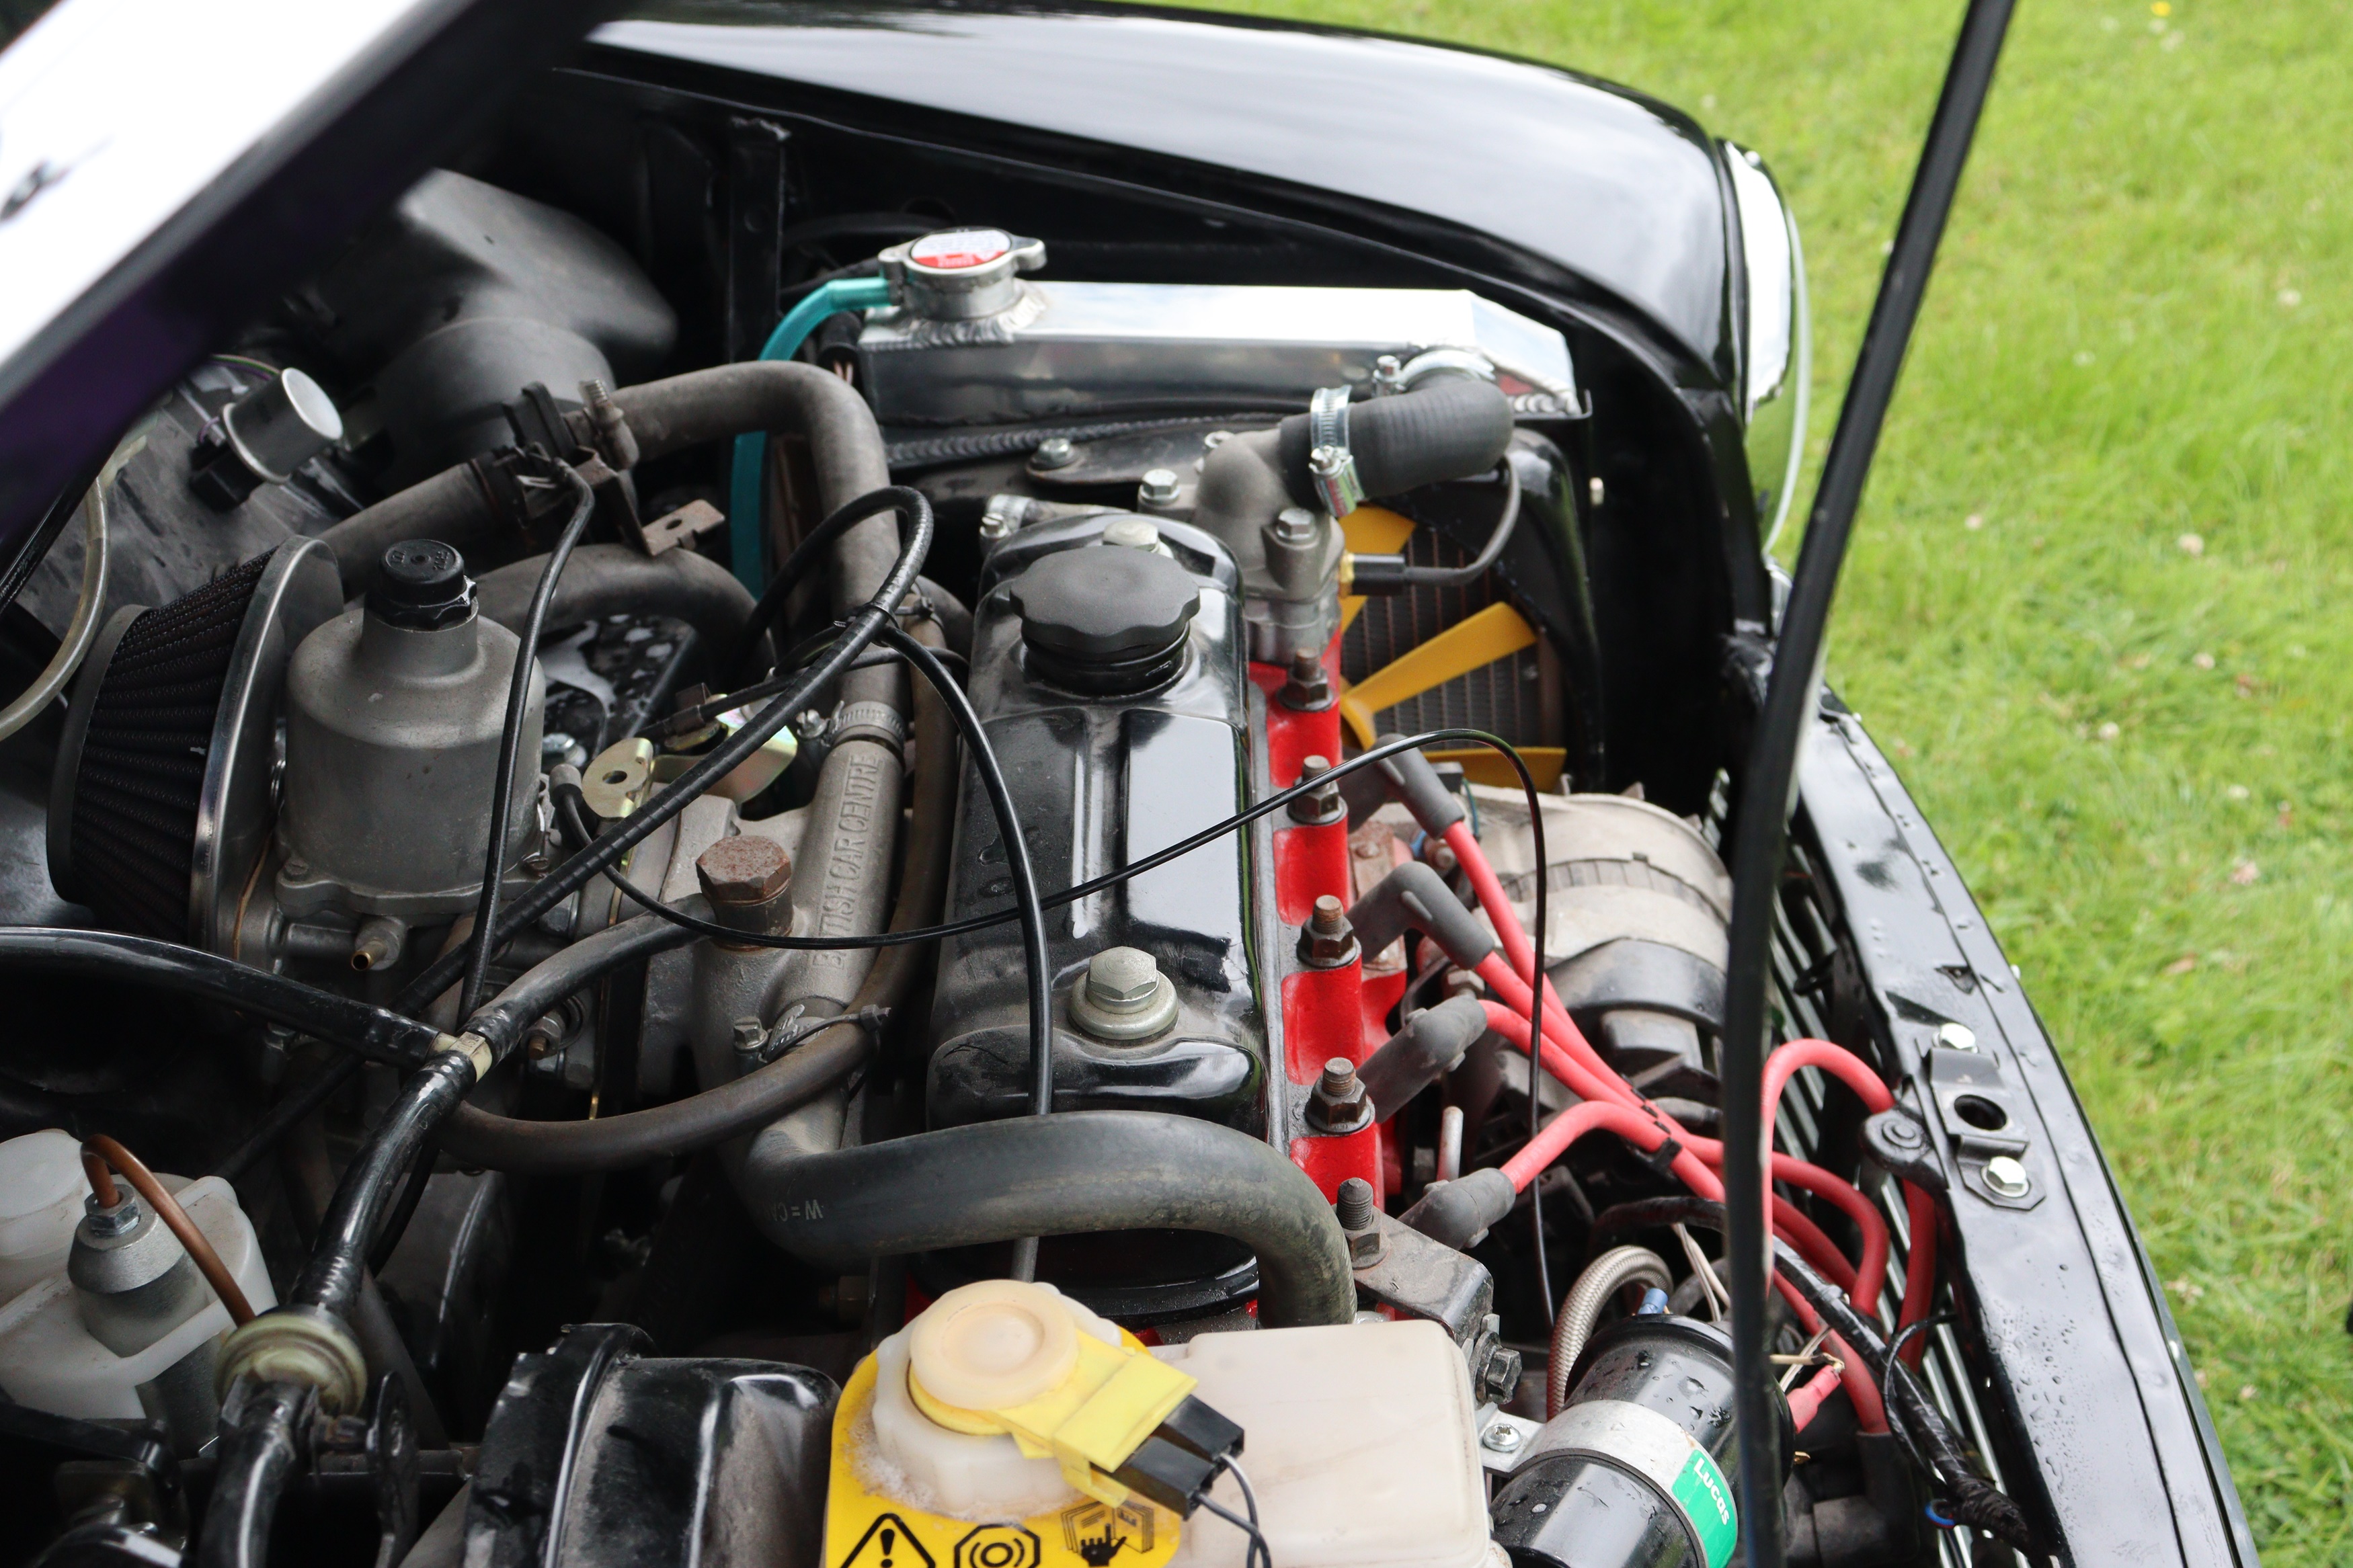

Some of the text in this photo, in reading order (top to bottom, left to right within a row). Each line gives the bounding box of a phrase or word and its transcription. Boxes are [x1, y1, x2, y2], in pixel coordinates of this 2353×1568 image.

[811, 755, 879, 971] BITISH CAR CENTRE
[1693, 1456, 1730, 1526] Lucas
